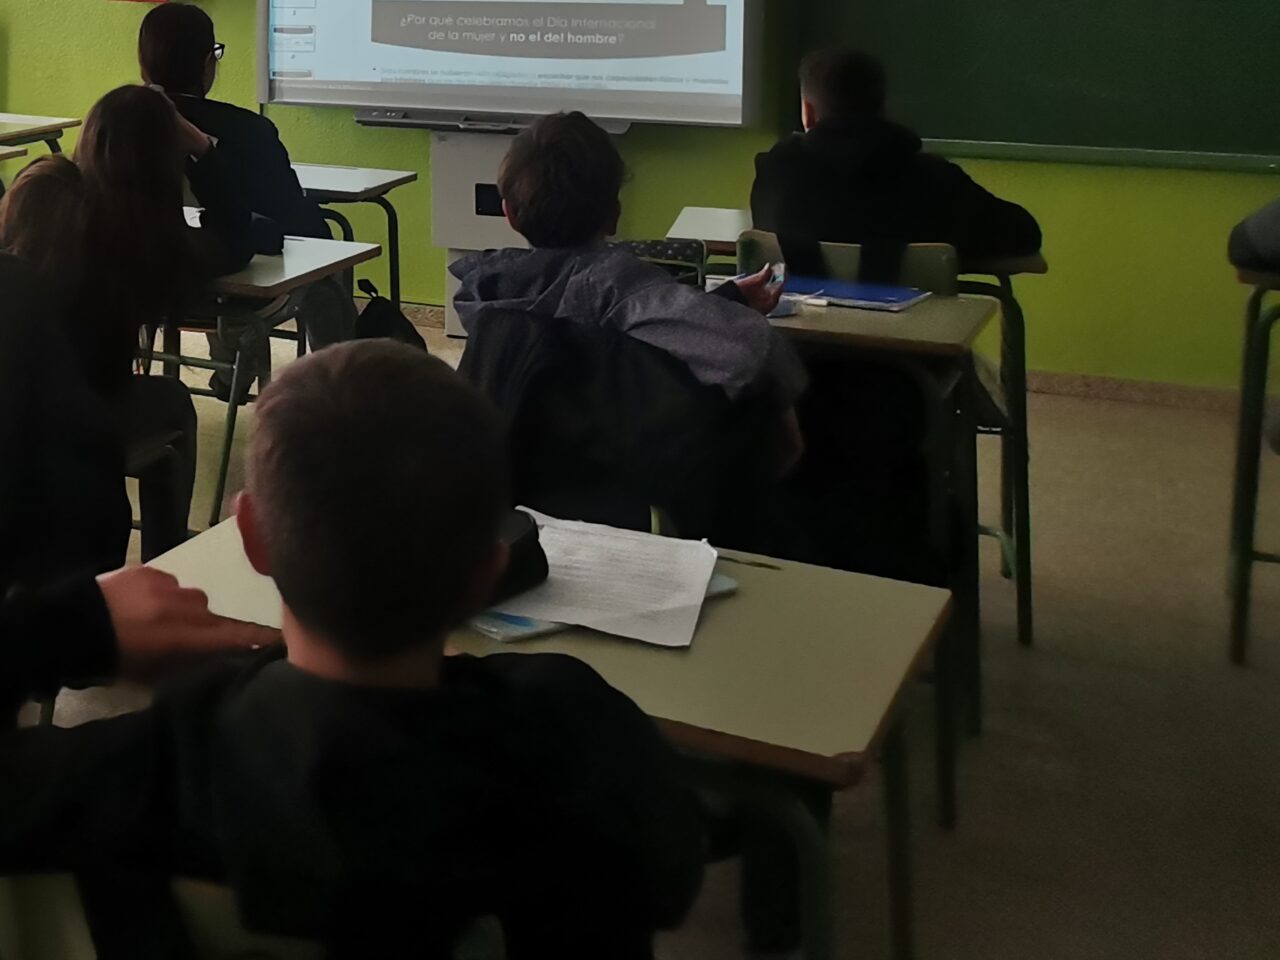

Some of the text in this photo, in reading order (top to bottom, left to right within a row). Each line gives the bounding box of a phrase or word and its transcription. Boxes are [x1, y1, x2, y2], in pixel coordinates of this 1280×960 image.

[400, 14, 426, 27] ¿Por
[429, 15, 454, 28] qué
[456, 15, 529, 27] celebramos
[532, 16, 543, 27] el
[428, 30, 446, 41] de
[447, 30, 460, 41] la
[462, 31, 496, 43] mujer
[499, 32, 507, 44] y
[509, 32, 525, 43] no
[528, 31, 540, 42] el
[543, 32, 564, 43] del
